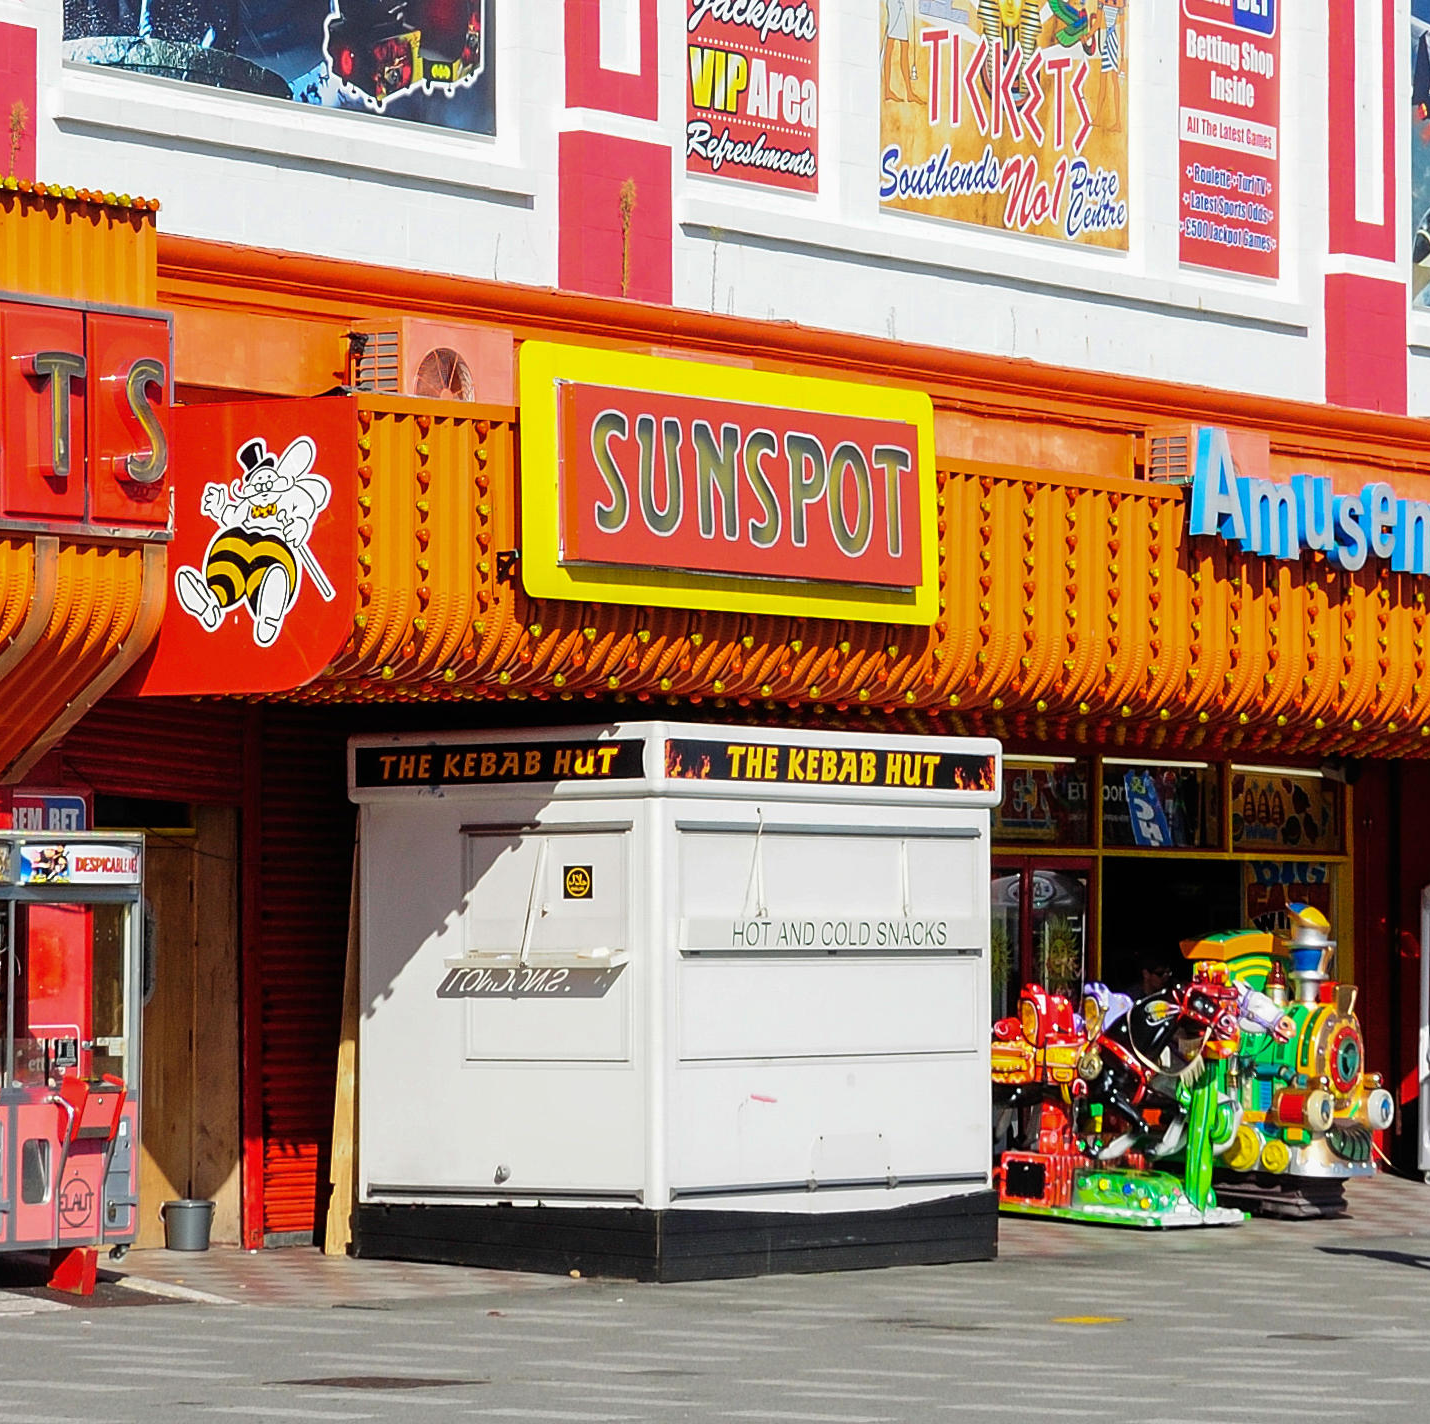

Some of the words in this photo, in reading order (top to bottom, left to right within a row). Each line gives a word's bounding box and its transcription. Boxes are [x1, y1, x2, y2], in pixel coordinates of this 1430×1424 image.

[1186, 28, 1240, 72] Betting
[1241, 41, 1274, 80] Shop
[688, 46, 748, 114] VIP
[746, 57, 817, 128] Area
[922, 29, 1093, 152] TICKETS
[1210, 70, 1255, 108] Inside
[686, 120, 817, 177] Refreshments
[1187, 116, 1199, 133] All
[1202, 118, 1217, 138] The
[1220, 122, 1245, 143] Latest
[1246, 128, 1272, 150] Games
[879, 149, 1000, 199] Southends
[1072, 160, 1117, 197] Prize
[1194, 163, 1231, 189] Roulette
[1067, 191, 1125, 236] Centre
[1191, 192, 1218, 211] Latest
[1219, 198, 1245, 219] Sports
[1247, 204, 1268, 223] Odds
[1244, 231, 1271, 251] Games
[591, 409, 912, 558] SUNSPOT
[380, 754, 438, 780] THE
[444, 749, 542, 778] KEBAB
[554, 745, 619, 777] HUT
[727, 744, 779, 782] THE
[784, 749, 878, 784] KEBAB
[885, 752, 941, 787] HUT
[49, 808, 79, 830] BET
[75, 857, 126, 873] DESPICABLE
[732, 922, 770, 947] HOT
[776, 921, 818, 946] AND
[822, 921, 870, 946] COLD
[877, 922, 947, 947] SNACKS
[60, 1192, 94, 1212] ELAUT
